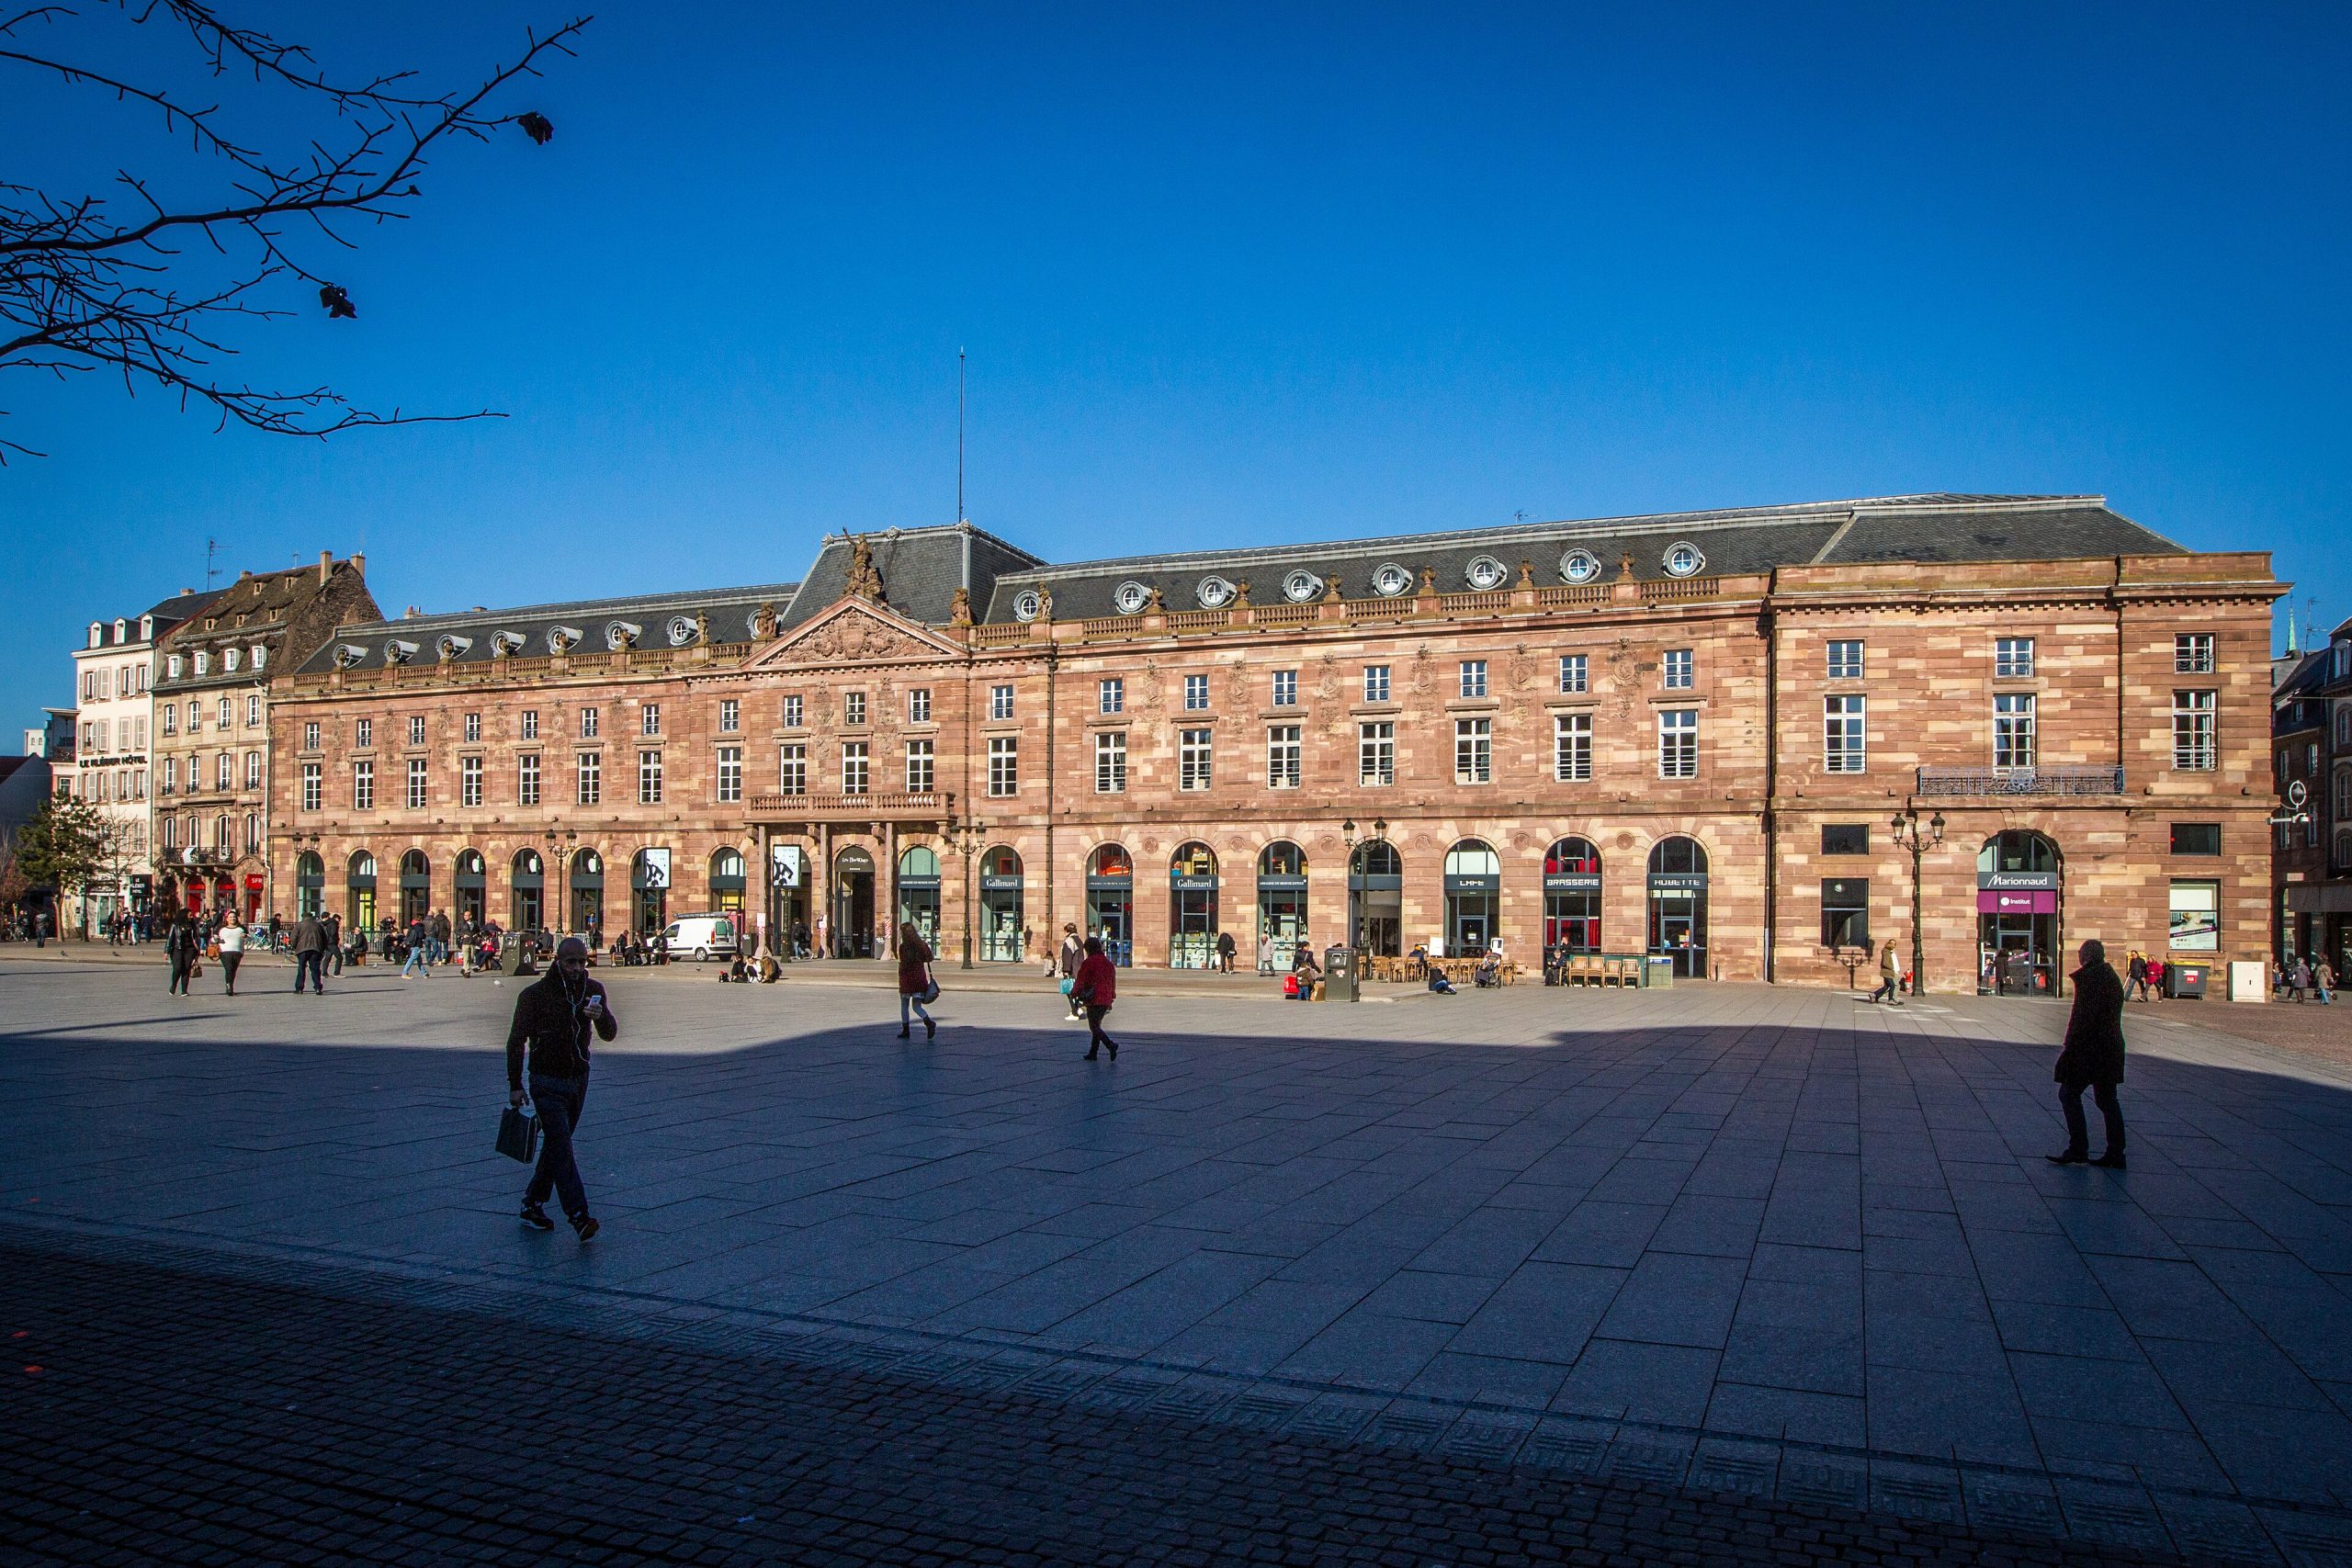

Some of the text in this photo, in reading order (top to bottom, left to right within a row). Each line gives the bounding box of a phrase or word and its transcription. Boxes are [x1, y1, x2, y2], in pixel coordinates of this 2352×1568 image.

[79, 760, 90, 768] LE
[121, 754, 148, 765] HÔTEL
[986, 878, 1018, 887] Gallimard
[1177, 878, 1212, 888] Gallimard
[1546, 878, 1600, 886] BRASSERIE
[1986, 874, 2048, 888] Marionnaud
